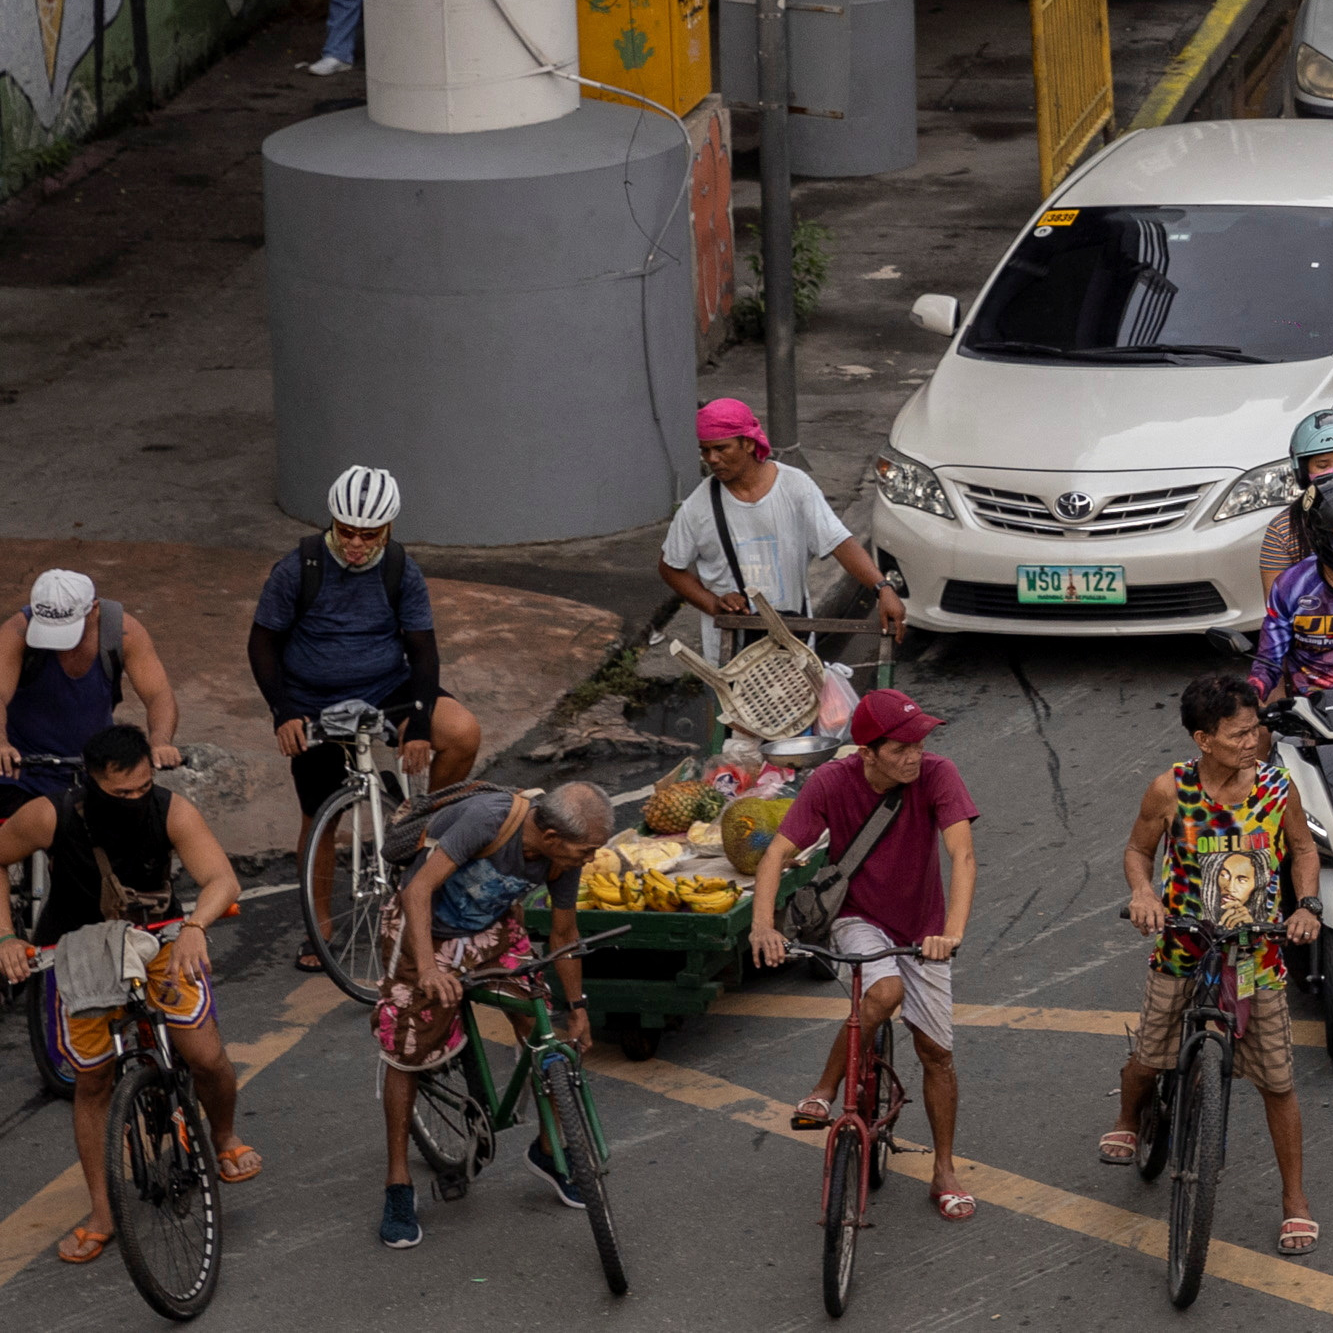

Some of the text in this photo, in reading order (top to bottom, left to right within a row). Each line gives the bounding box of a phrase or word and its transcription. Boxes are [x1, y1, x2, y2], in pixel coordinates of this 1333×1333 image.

[1026, 570, 1117, 592] WSQ 122
[1197, 832, 1270, 854] ONE LOVE
